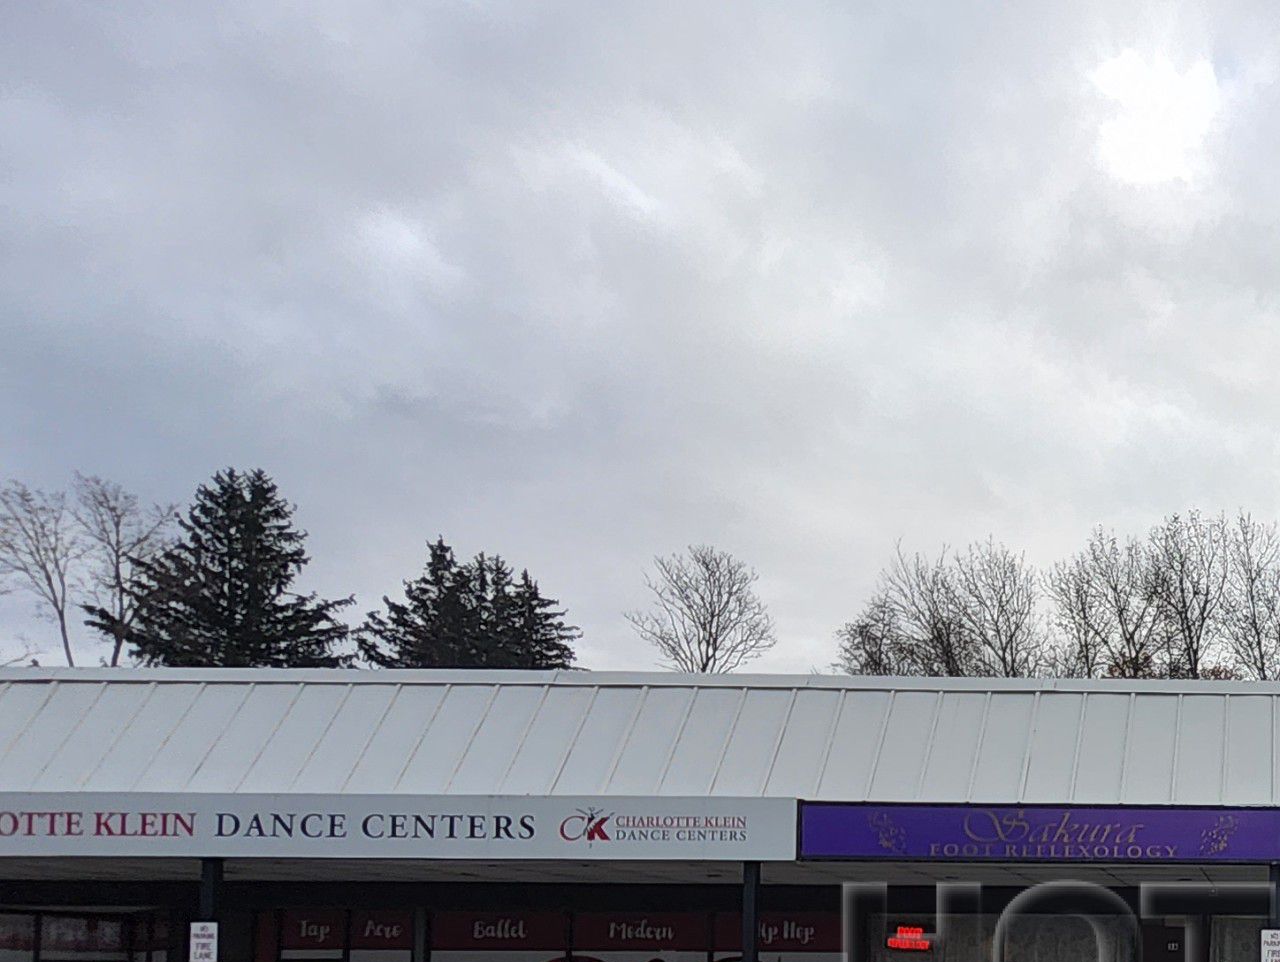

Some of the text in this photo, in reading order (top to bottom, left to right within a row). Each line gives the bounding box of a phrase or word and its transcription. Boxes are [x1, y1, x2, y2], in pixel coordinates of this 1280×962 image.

[93, 812, 197, 837] KLEIN
[215, 813, 347, 839] DANCE
[361, 813, 536, 840] CENTERS
[615, 816, 747, 829] CHARLOTTE KLEIN
[964, 808, 1145, 845] Sakura
[615, 830, 747, 841] DANCE CENTERS
[929, 844, 1178, 860] FOOT REFLEXOLOGY
[299, 919, 331, 942] Tap
[609, 918, 676, 941] Modern
